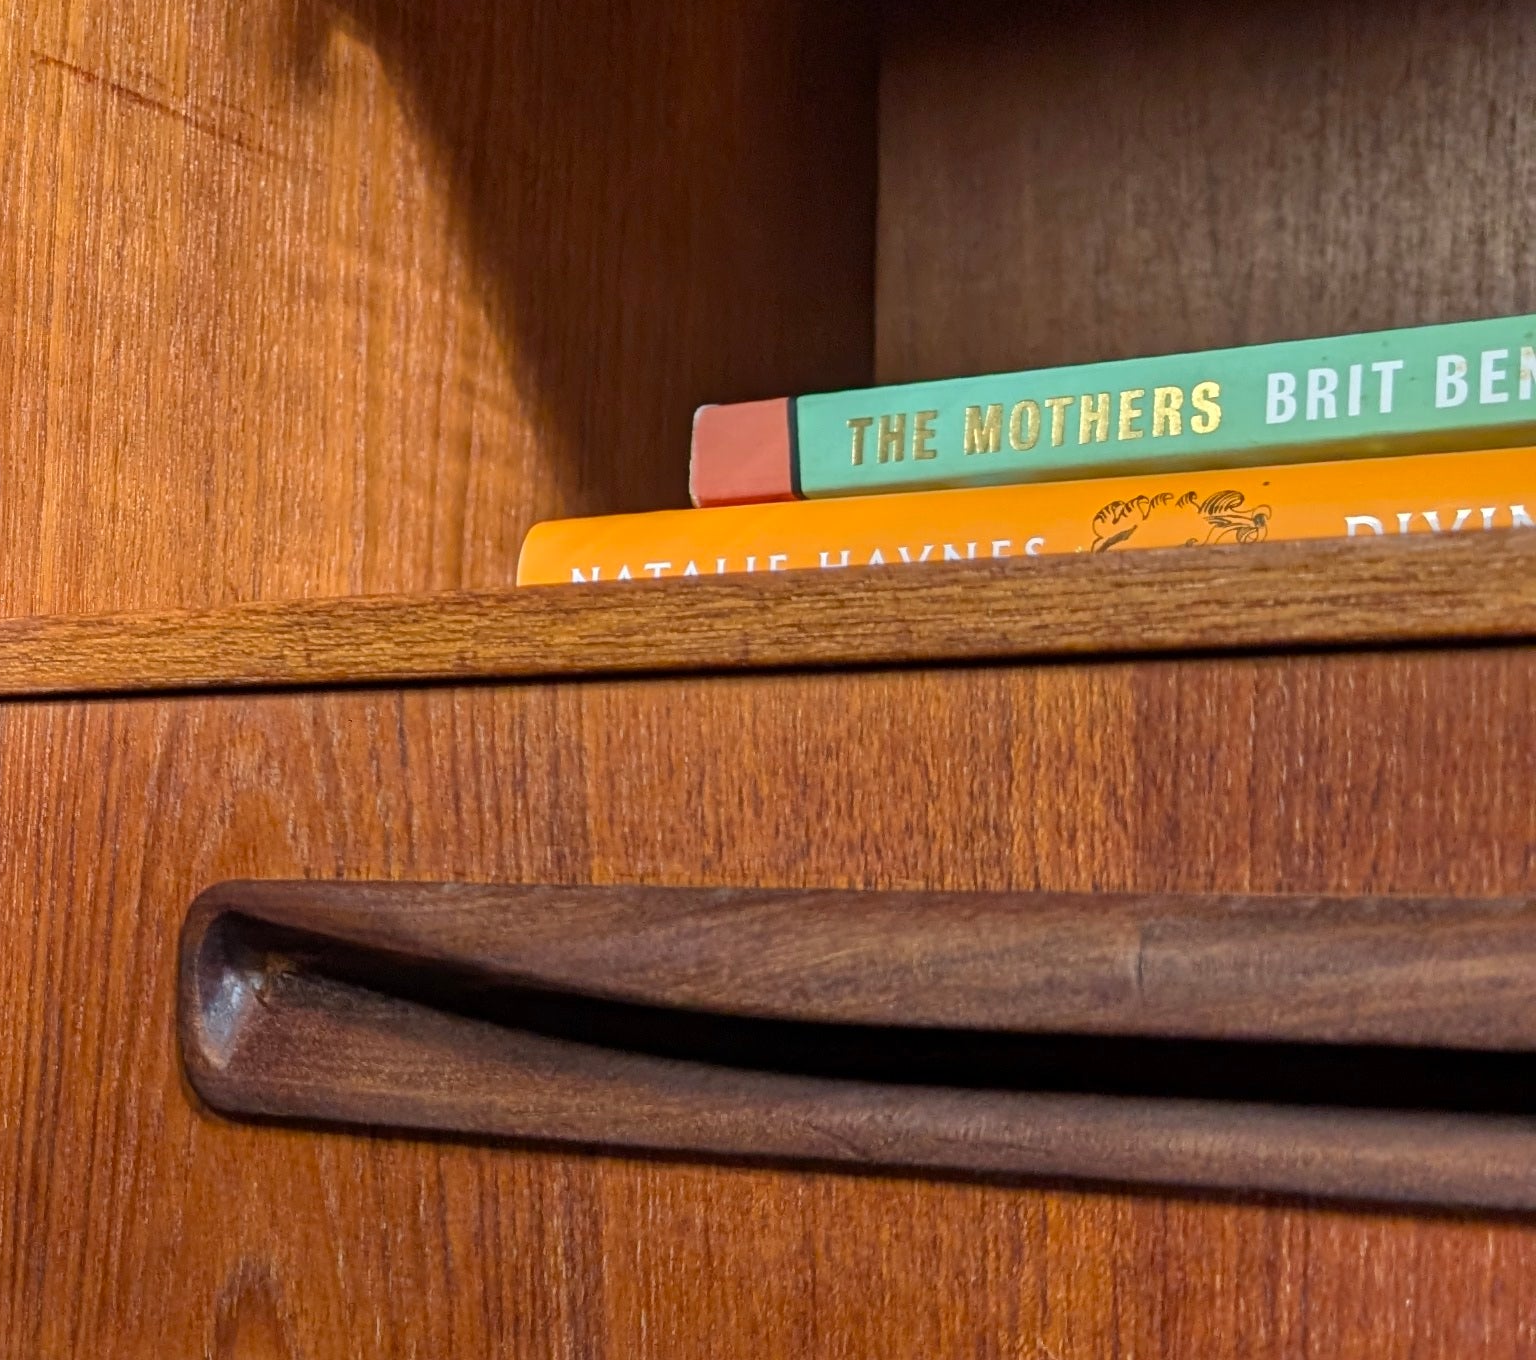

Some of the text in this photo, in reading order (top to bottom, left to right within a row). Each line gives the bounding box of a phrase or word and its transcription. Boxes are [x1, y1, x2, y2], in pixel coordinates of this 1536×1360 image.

[847, 409, 939, 466] THE
[963, 380, 1223, 457] MOTHERS
[1266, 359, 1405, 425] BRIT
